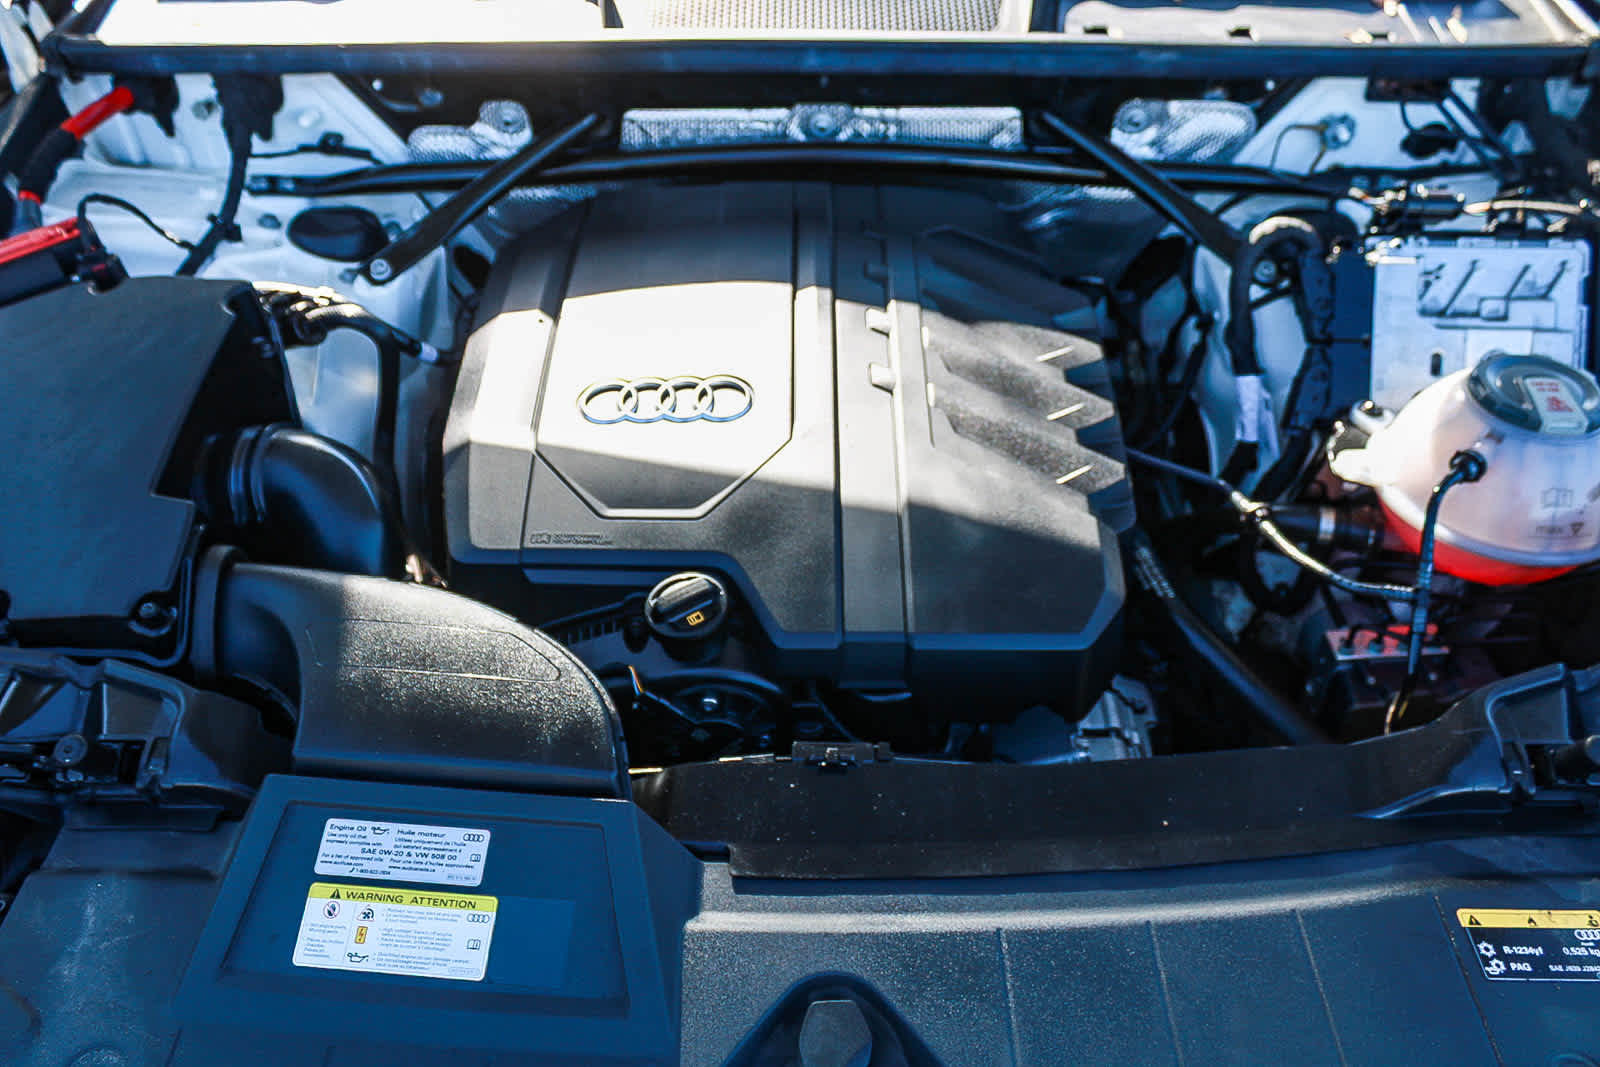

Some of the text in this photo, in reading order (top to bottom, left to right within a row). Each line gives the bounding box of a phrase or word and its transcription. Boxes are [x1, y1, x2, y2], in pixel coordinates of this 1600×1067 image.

[346, 890, 477, 909] WARNING ATTENTION
[1502, 946, 1544, 956] R-1234yf
[1590, 948, 1600, 957] kg
[1510, 962, 1532, 972] PAG
